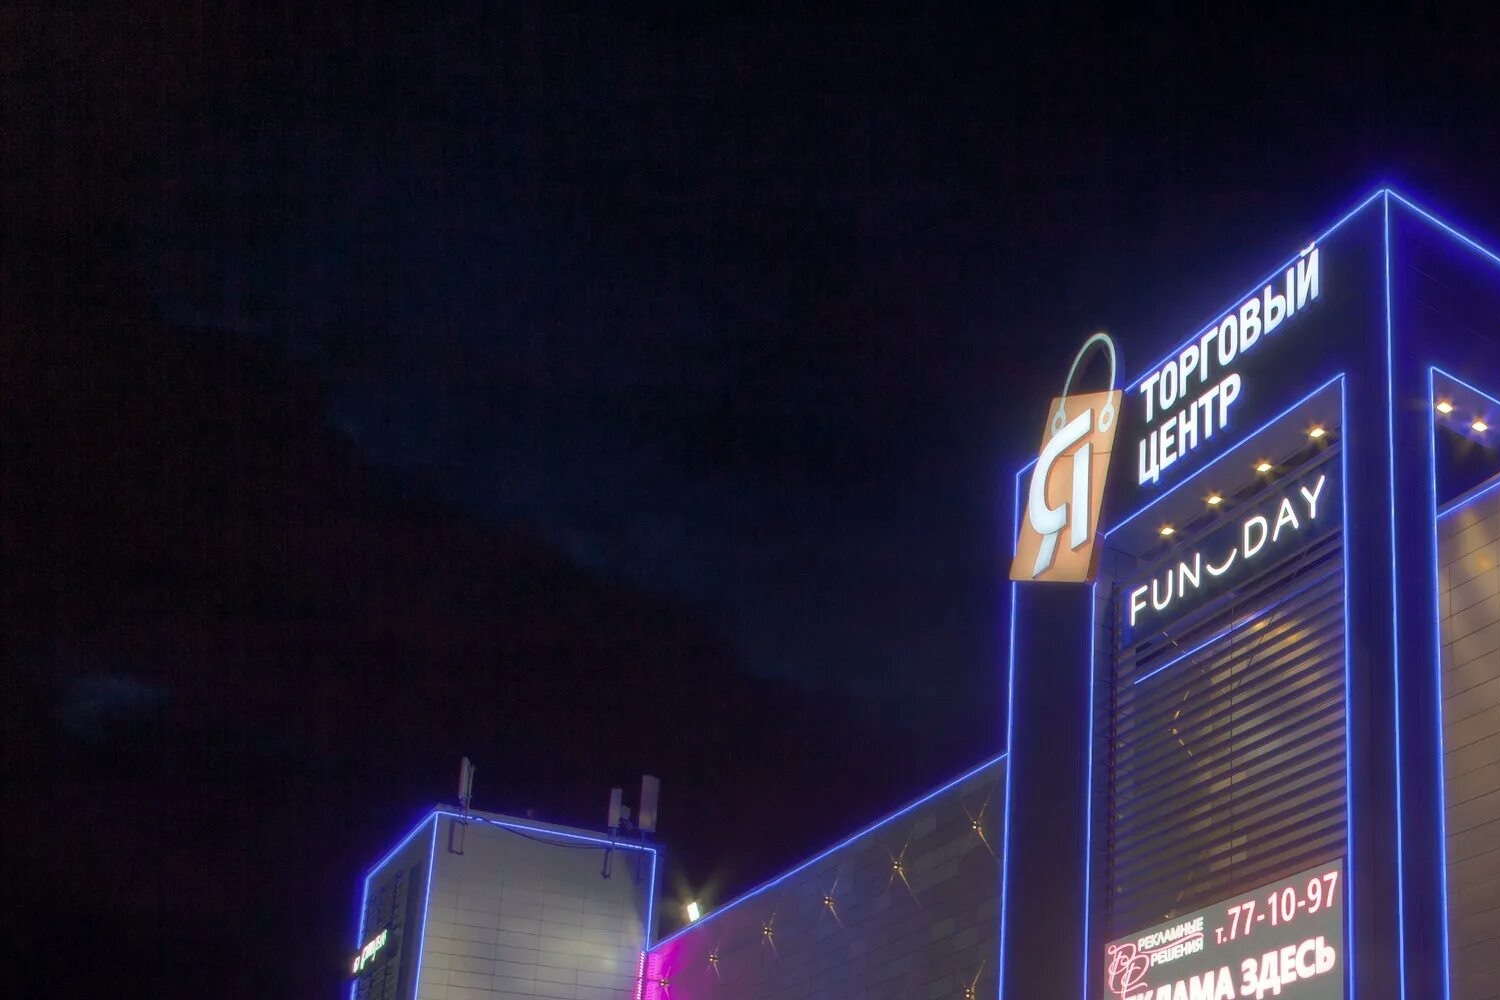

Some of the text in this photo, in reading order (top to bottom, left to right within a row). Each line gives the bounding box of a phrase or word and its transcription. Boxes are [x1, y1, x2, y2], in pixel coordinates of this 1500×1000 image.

[1140, 242, 1319, 423] ТОРГОВЫЙ
[1139, 373, 1242, 486] ЦЕНТР
[1130, 475, 1326, 627] FUN DAY
[1137, 917, 1204, 952] РЕКЛАМНЫЕ
[1150, 937, 1204, 967] РЕШЕНИЯ
[1240, 936, 1336, 1000] ЗДЕСЬ
